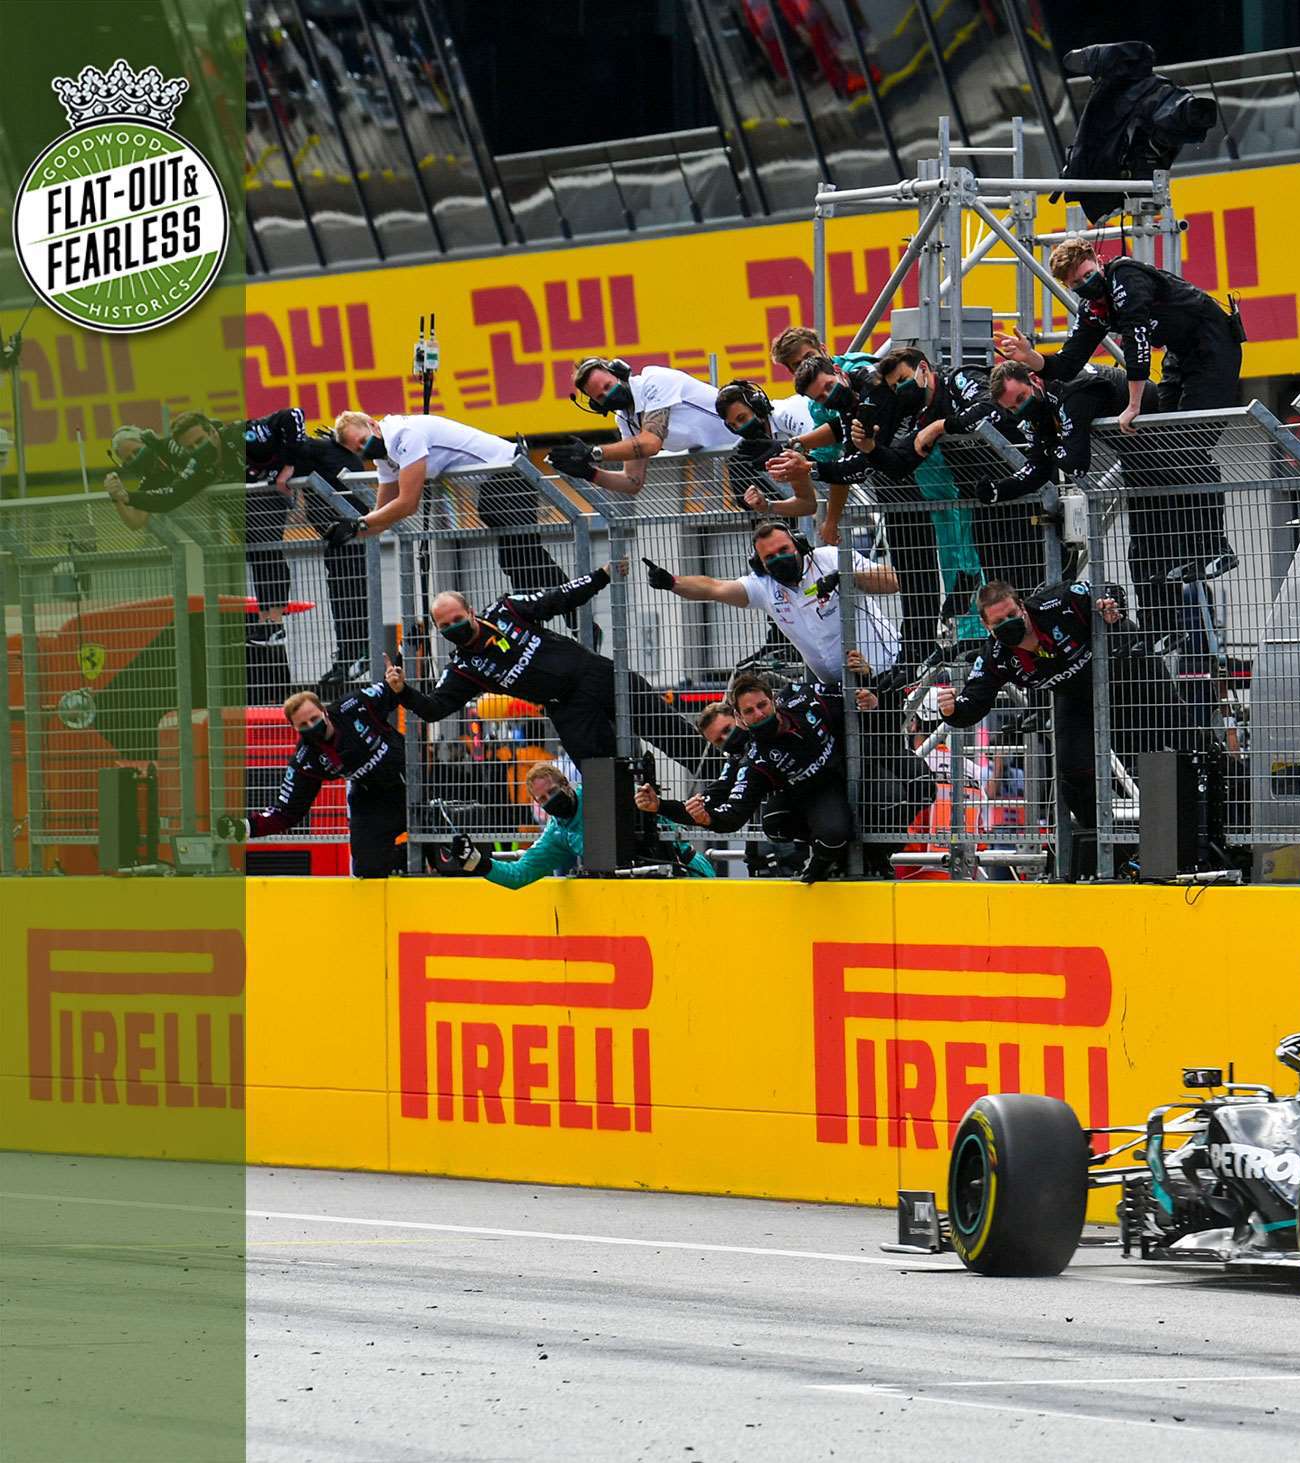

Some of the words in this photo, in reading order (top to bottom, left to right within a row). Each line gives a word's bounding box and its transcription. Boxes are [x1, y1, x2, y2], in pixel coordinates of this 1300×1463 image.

[222, 302, 404, 424] DHL
[471, 274, 670, 405] DHL
[500, 635, 542, 689] PETRONAS
[26, 928, 246, 1110] PIRELLI
[398, 931, 654, 1133] PIRELLI
